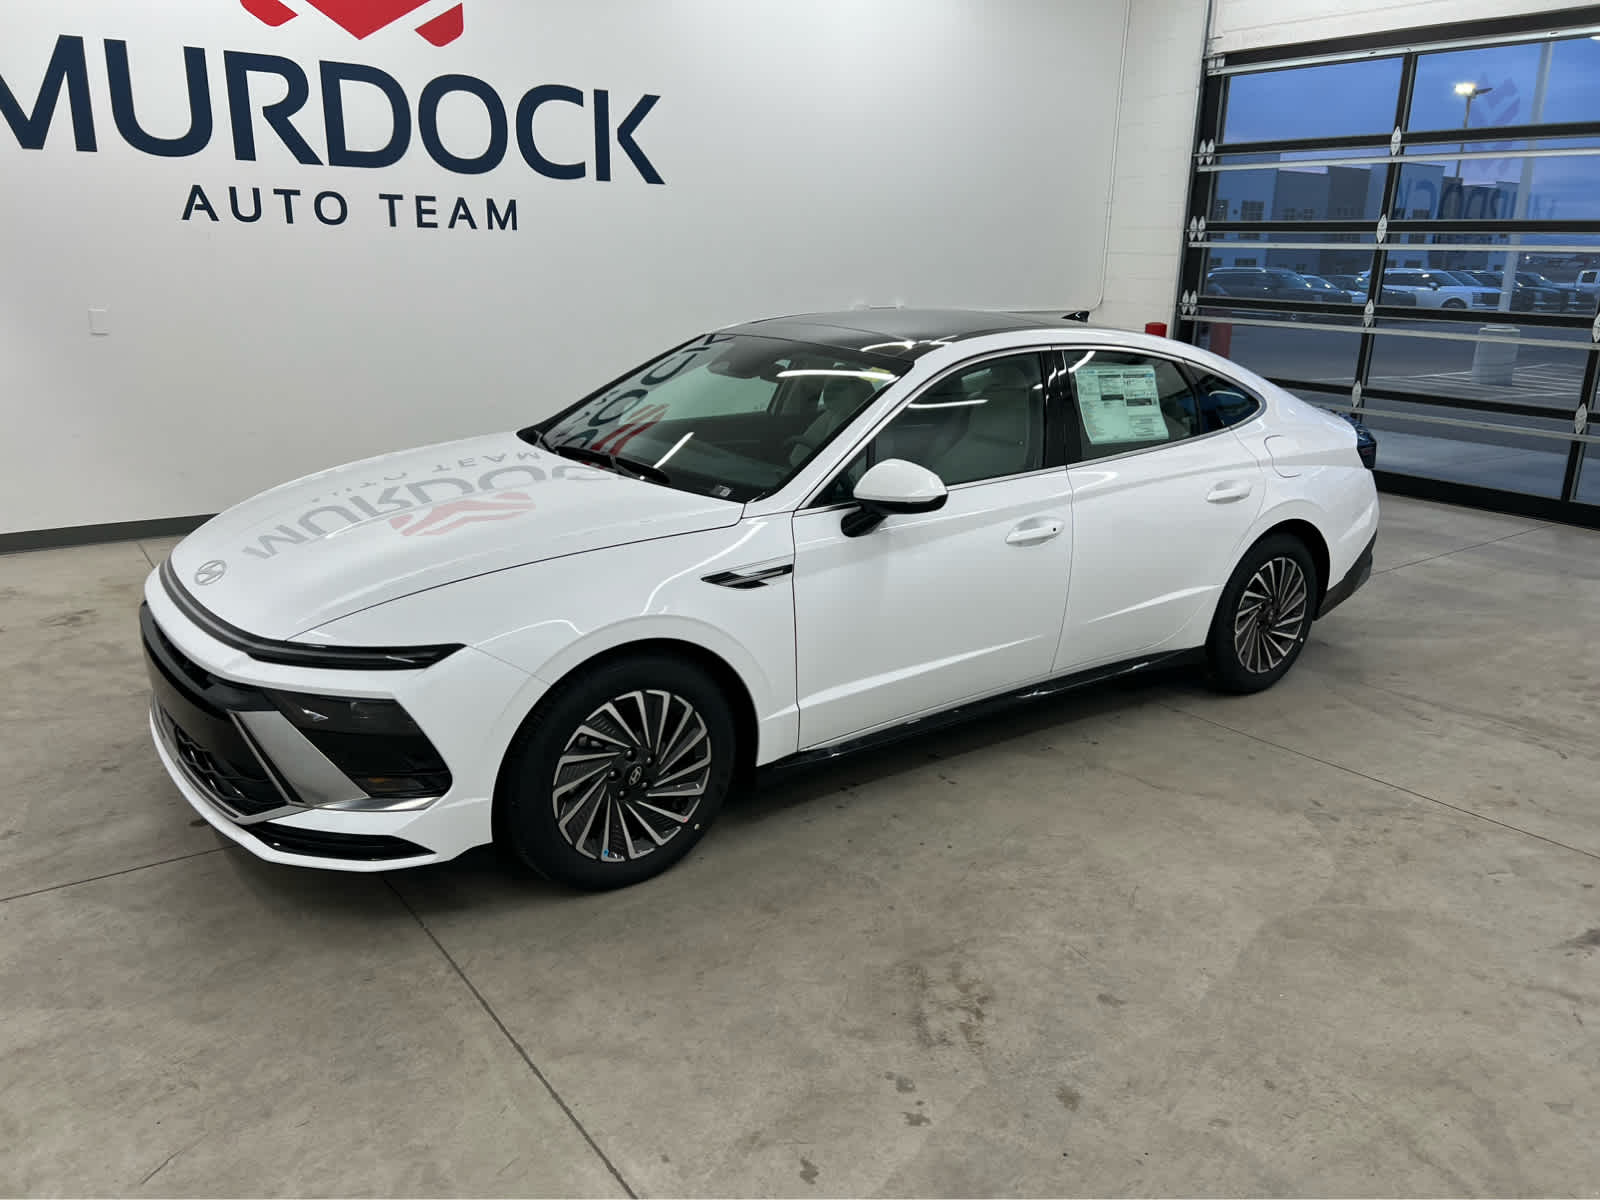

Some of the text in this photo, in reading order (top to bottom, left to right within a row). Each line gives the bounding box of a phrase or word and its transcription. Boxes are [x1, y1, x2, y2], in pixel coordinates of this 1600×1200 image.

[0, 34, 666, 185] MURDOCK
[181, 184, 518, 231] AUTO TEAM
